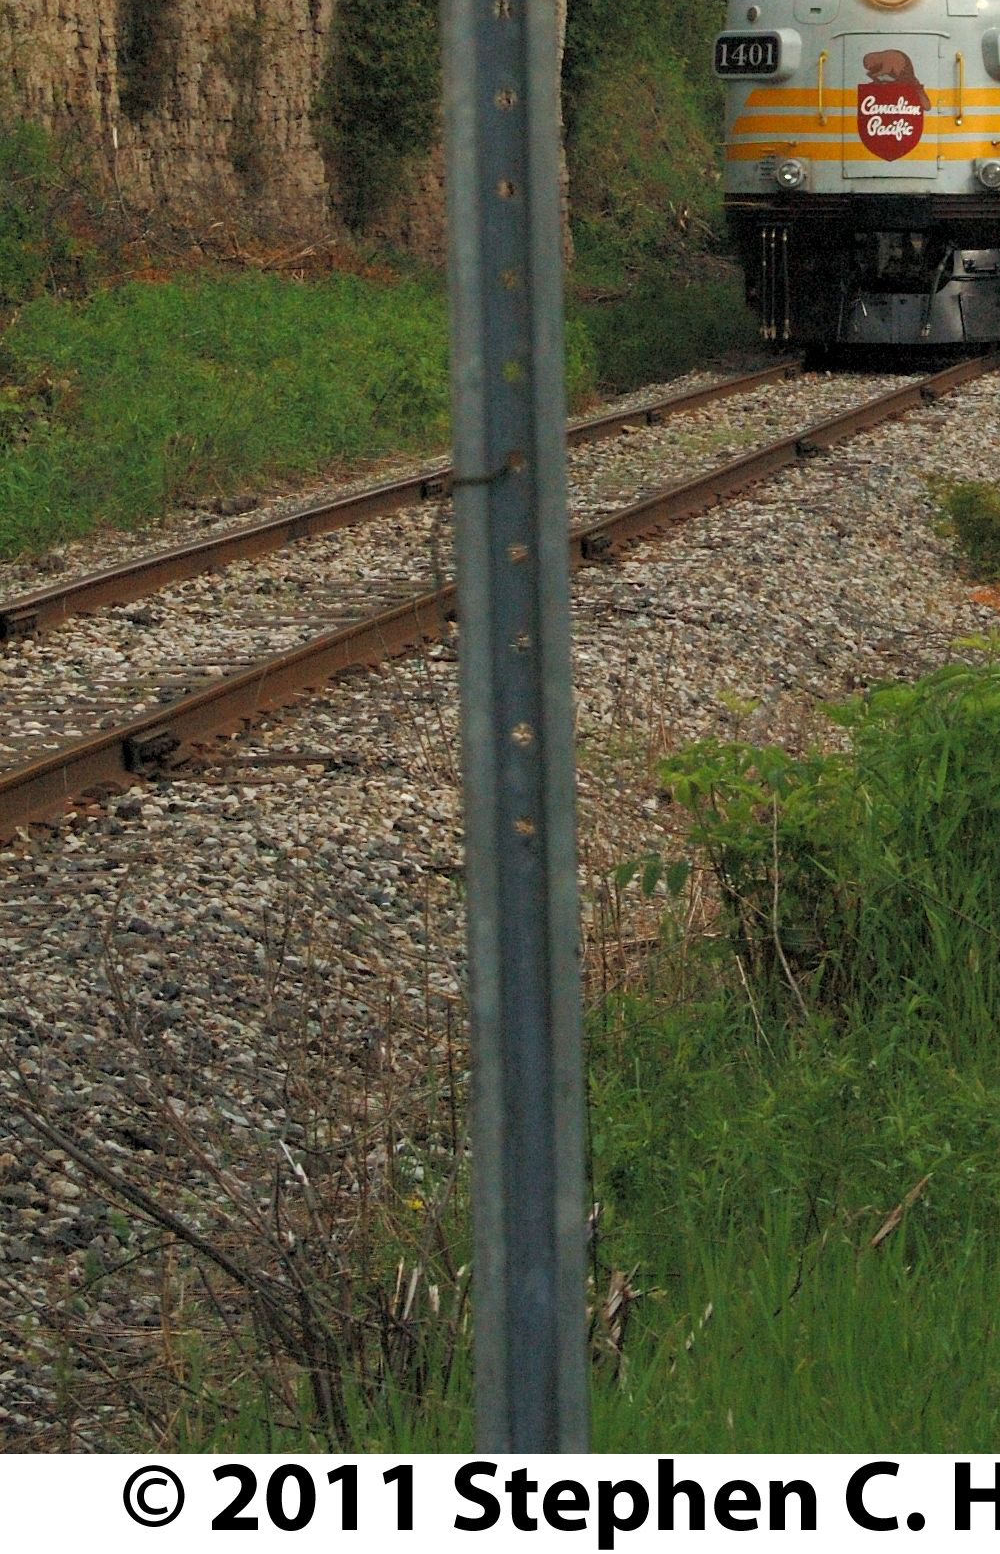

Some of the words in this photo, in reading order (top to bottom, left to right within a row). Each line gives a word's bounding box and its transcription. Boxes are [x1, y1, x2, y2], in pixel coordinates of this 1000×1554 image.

[719, 43, 774, 66] 1401
[861, 95, 922, 115] Canadian
[867, 115, 914, 141] Pacific
